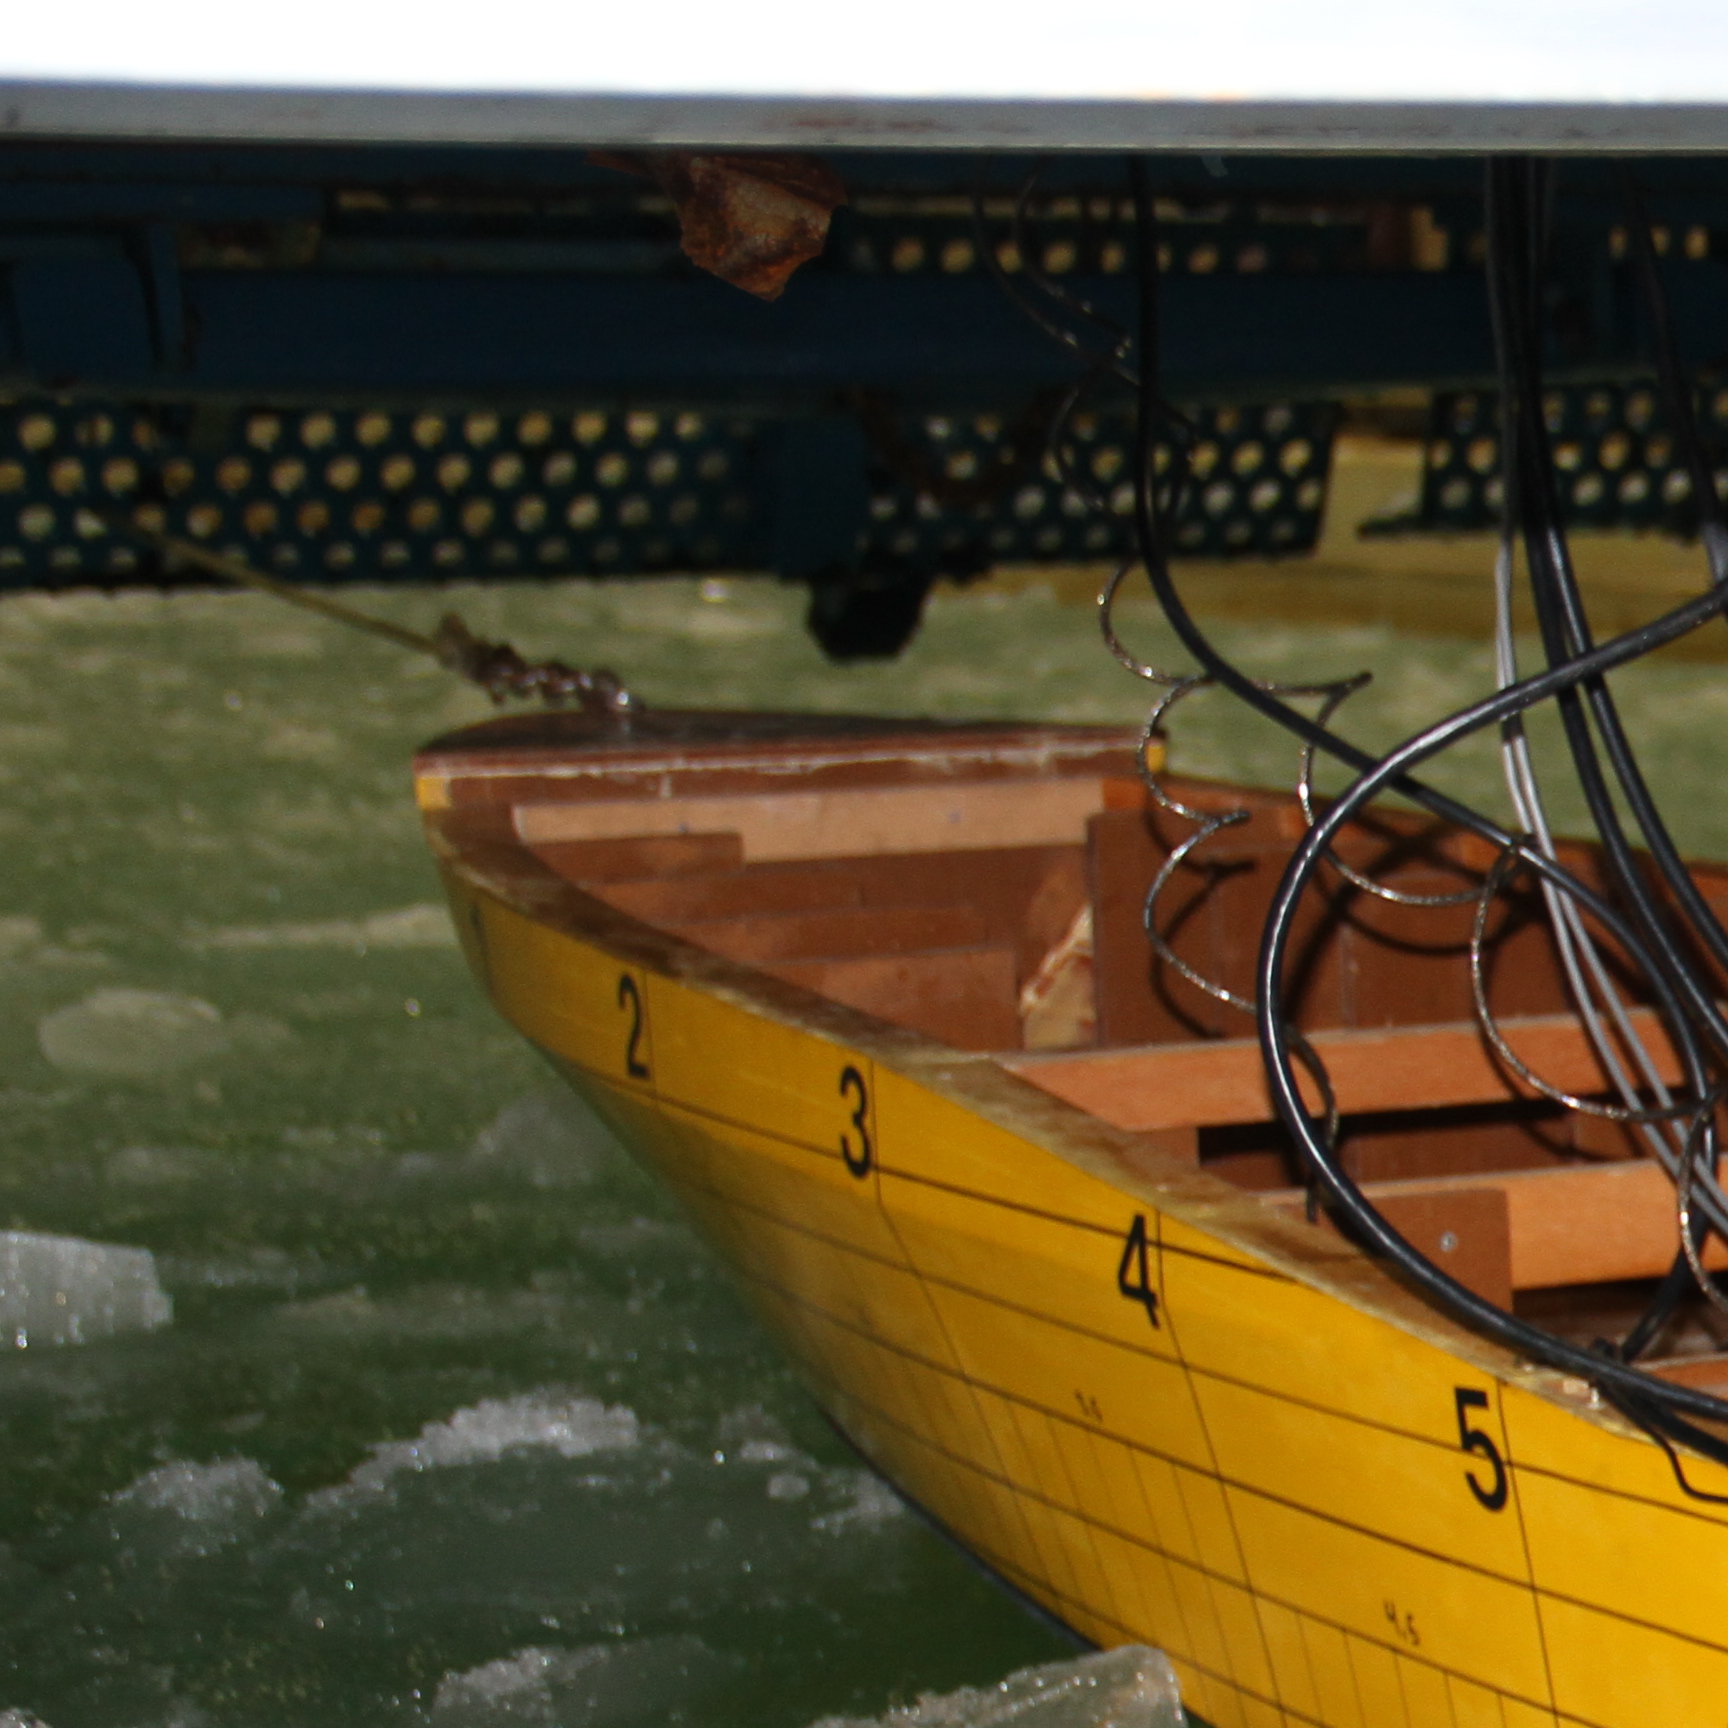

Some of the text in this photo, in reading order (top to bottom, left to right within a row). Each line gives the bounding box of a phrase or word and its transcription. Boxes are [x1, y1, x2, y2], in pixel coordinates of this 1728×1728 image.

[617, 973, 650, 1081] 2
[840, 1065, 871, 1179] 3
[1117, 1214, 1160, 1329] 4
[1454, 1387, 1508, 1511] 5
